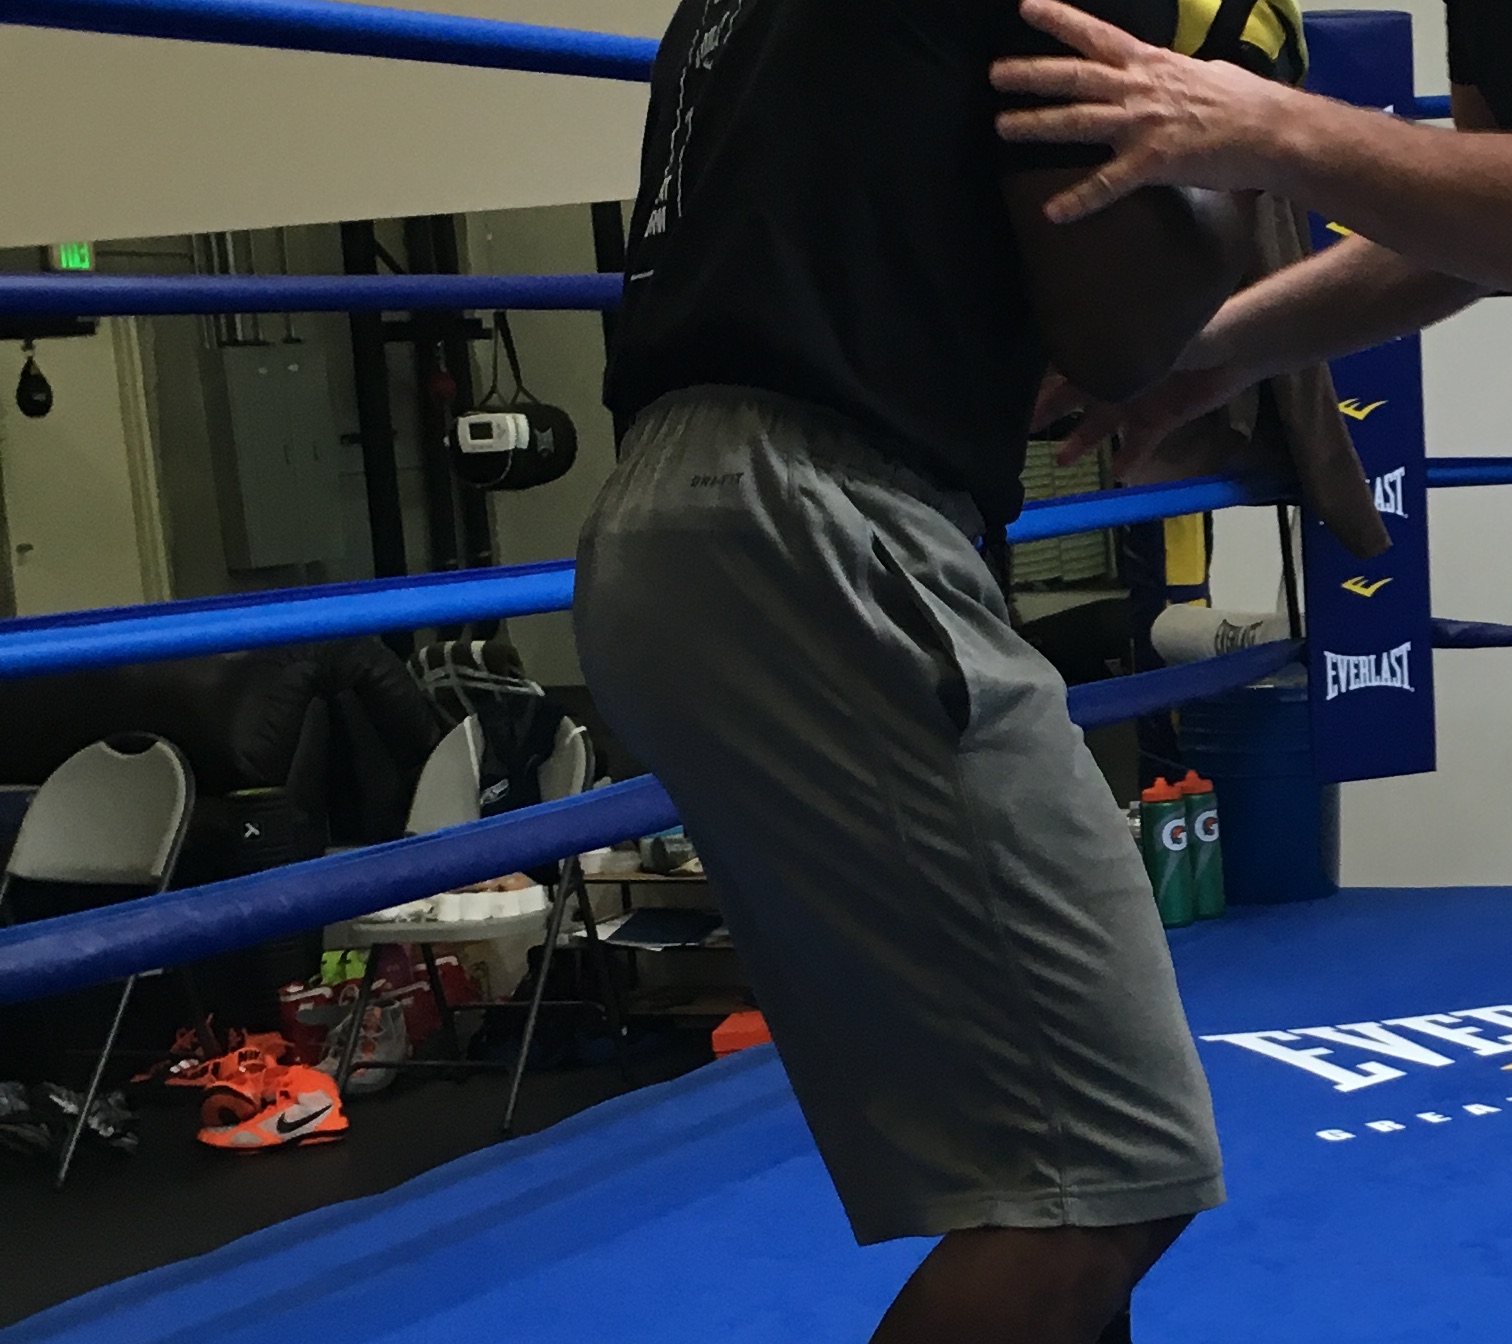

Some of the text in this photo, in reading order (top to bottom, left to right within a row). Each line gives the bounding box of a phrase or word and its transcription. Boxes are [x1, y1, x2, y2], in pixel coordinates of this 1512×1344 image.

[1324, 641, 1412, 700] EVERLAST
[1162, 817, 1187, 851] G
[1194, 809, 1220, 842] G
